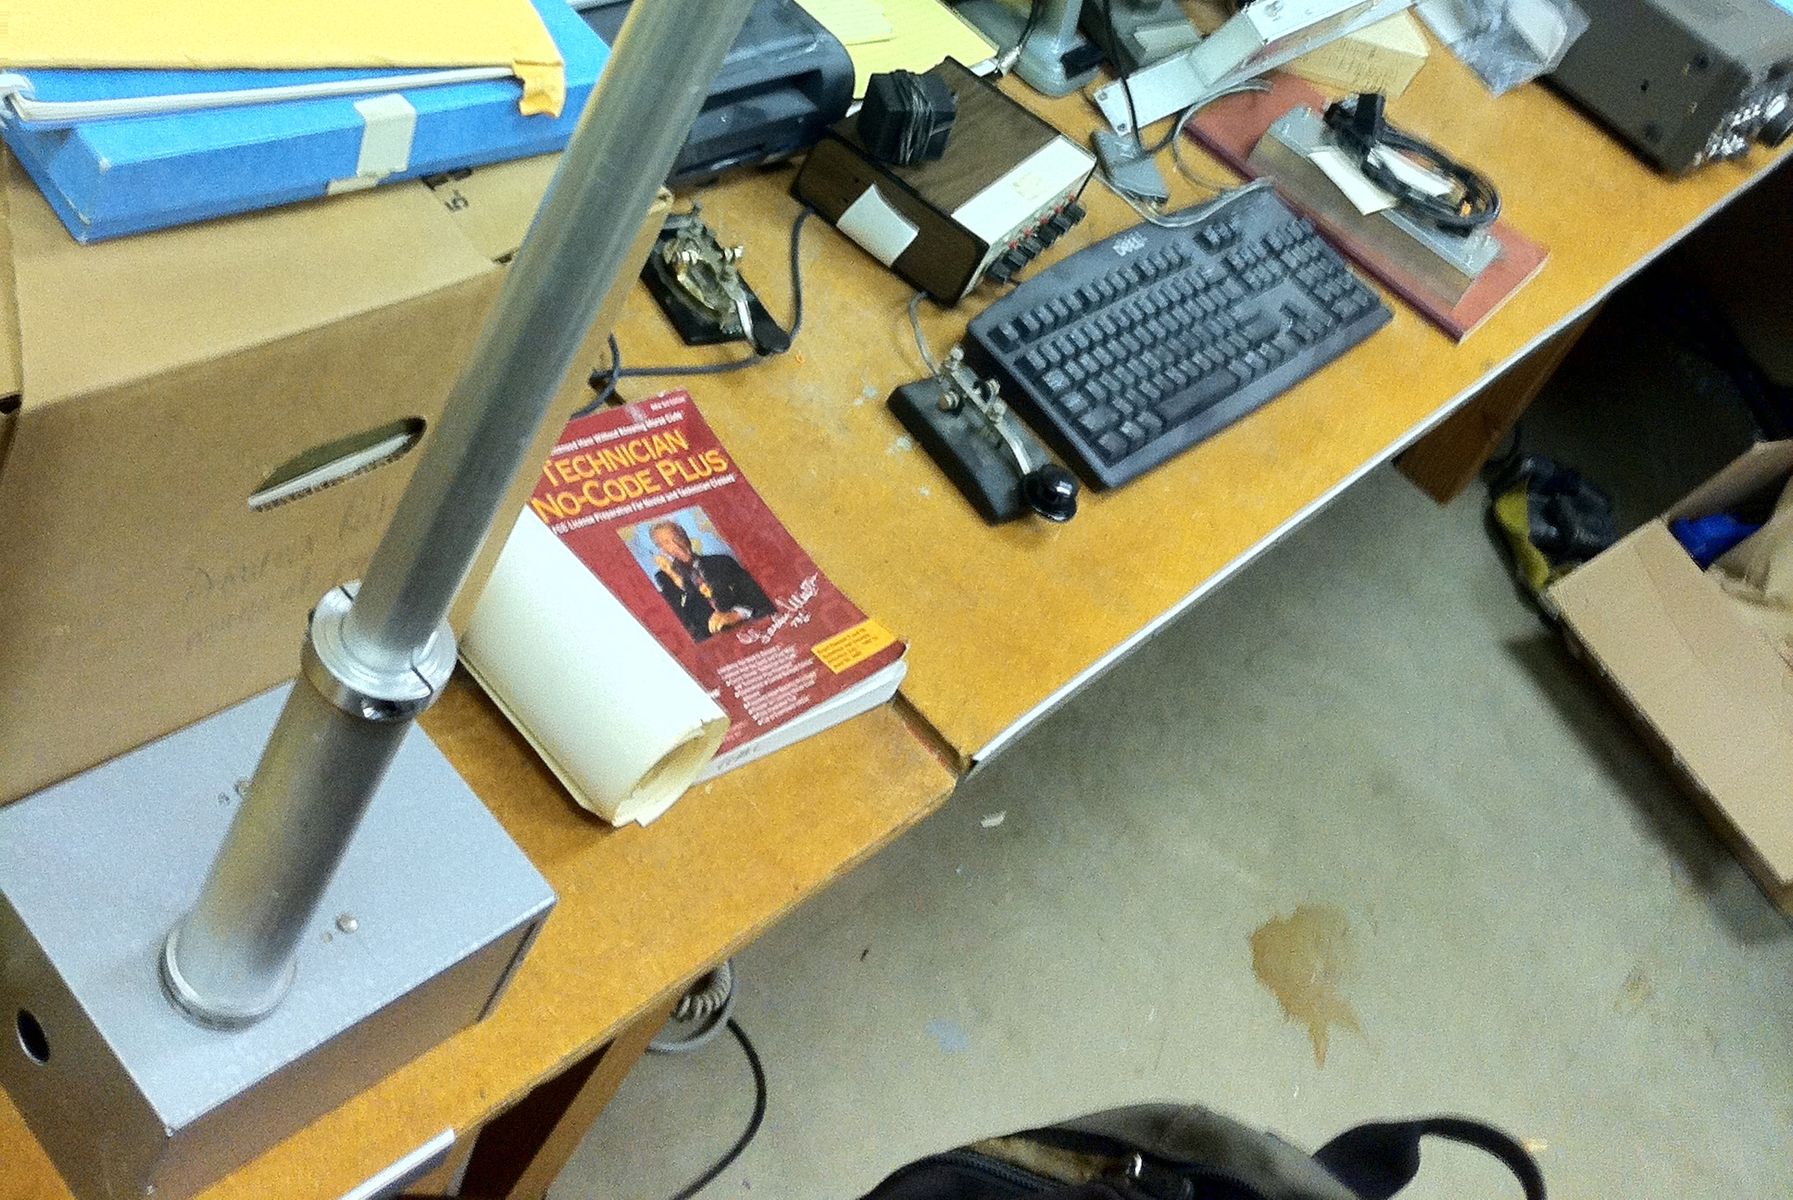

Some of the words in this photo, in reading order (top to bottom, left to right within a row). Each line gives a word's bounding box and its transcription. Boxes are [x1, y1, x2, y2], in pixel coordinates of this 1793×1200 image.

[1112, 231, 1147, 257] DELL
[542, 429, 689, 487] TECHNICIAN
[655, 450, 728, 487] PLUS
